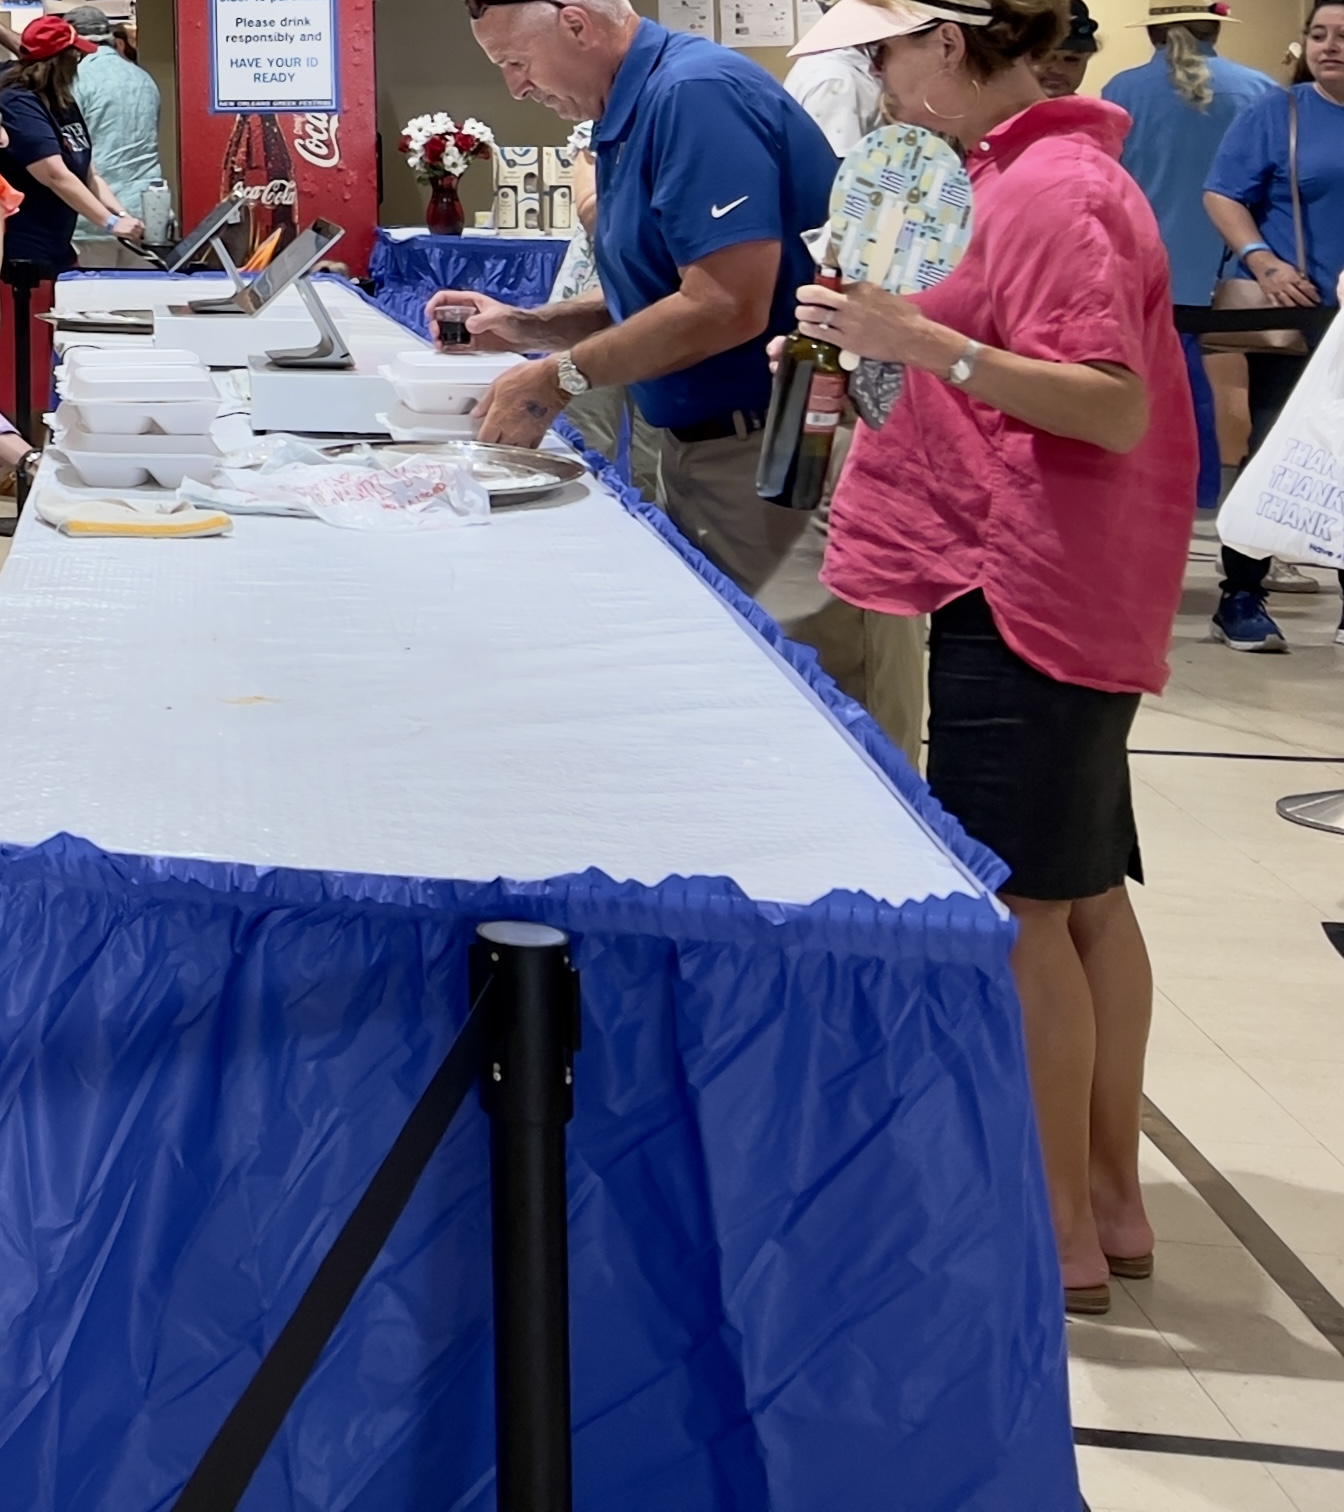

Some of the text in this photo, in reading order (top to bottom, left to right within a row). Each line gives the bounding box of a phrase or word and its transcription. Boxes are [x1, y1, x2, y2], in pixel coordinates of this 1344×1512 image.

[235, 16, 311, 28] Please drink
[226, 32, 323, 44] responsibly and
[229, 57, 319, 68] HAVE YOUR ID
[253, 72, 296, 83] READY
[1256, 491, 1339, 542] THANK
